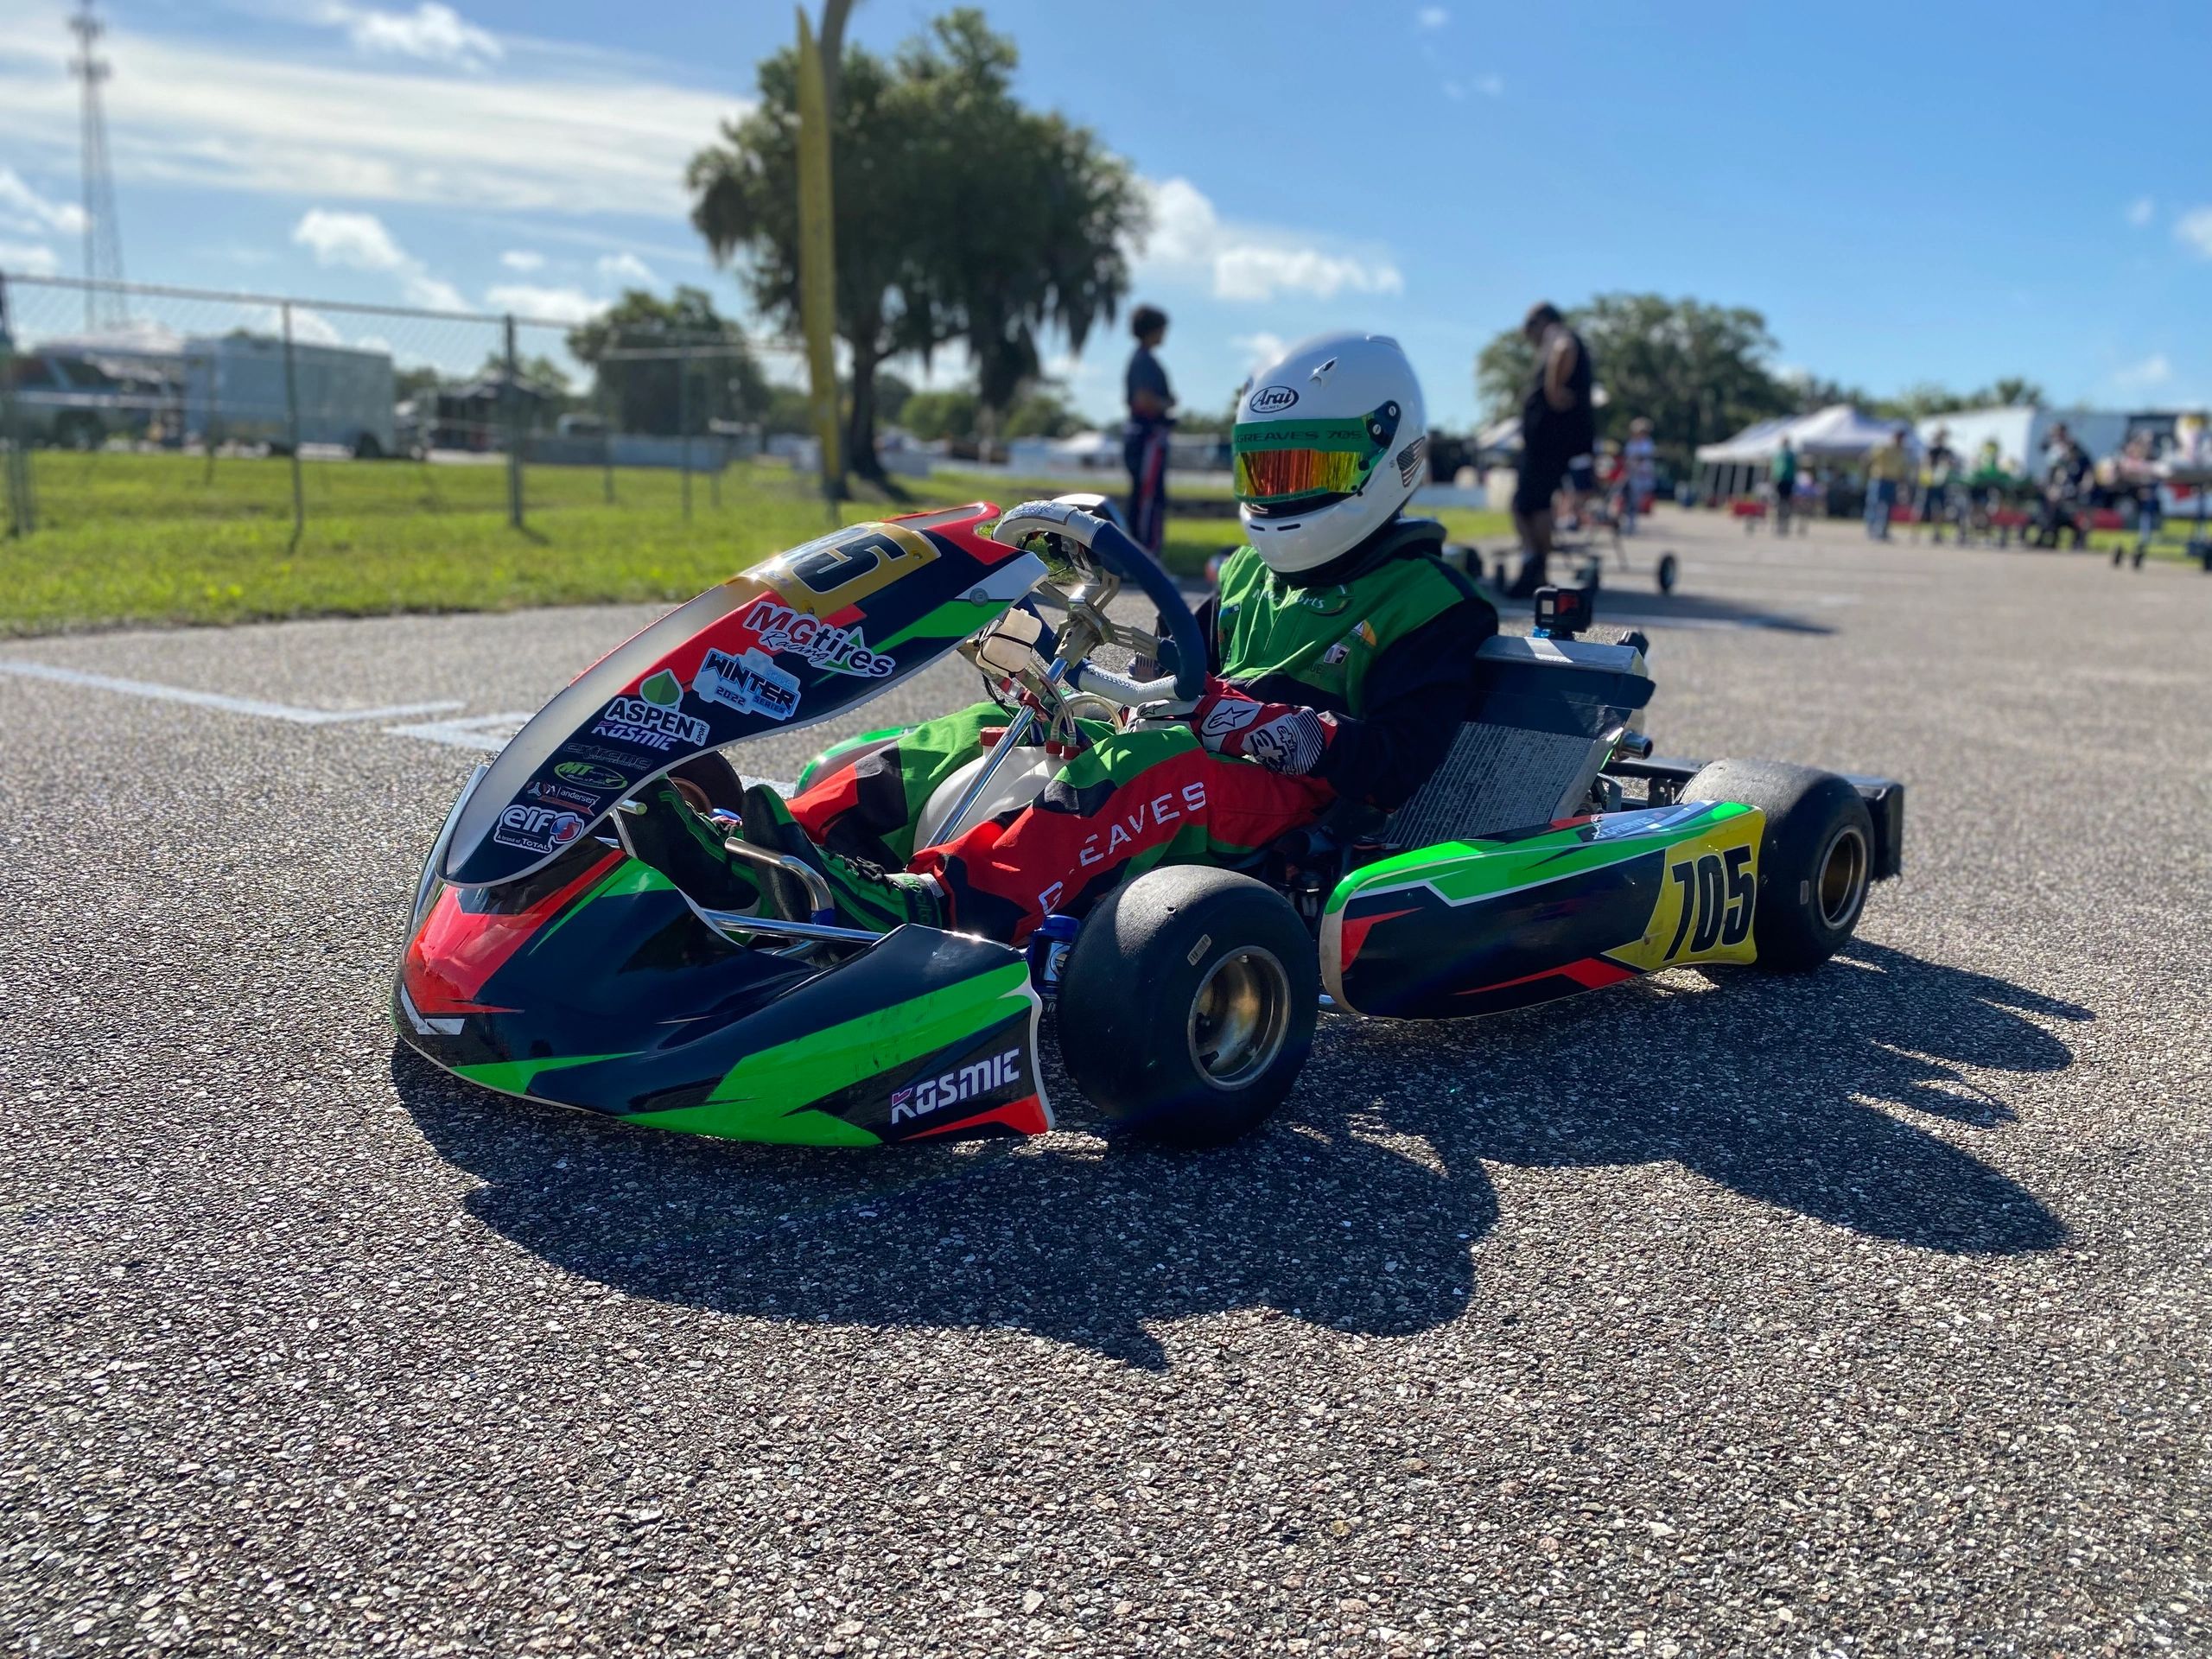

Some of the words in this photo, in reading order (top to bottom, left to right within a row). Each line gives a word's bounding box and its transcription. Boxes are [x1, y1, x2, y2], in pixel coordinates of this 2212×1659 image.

[1252, 389, 1294, 406] Arai
[761, 631, 831, 662] Racing
[703, 652, 797, 711] WINTER
[715, 686, 747, 706] 2022
[754, 696, 785, 715] SERIES
[607, 700, 696, 739] ASPEN
[696, 723, 706, 743] SPORT
[559, 761, 594, 776] MT
[560, 788, 597, 806] andersen
[503, 807, 556, 833] elf
[522, 837, 550, 851] TOTAL
[1038, 781, 1207, 914] GEAVES
[1662, 844, 1756, 963] 705
[891, 1048, 1020, 1125] KOSMIC
